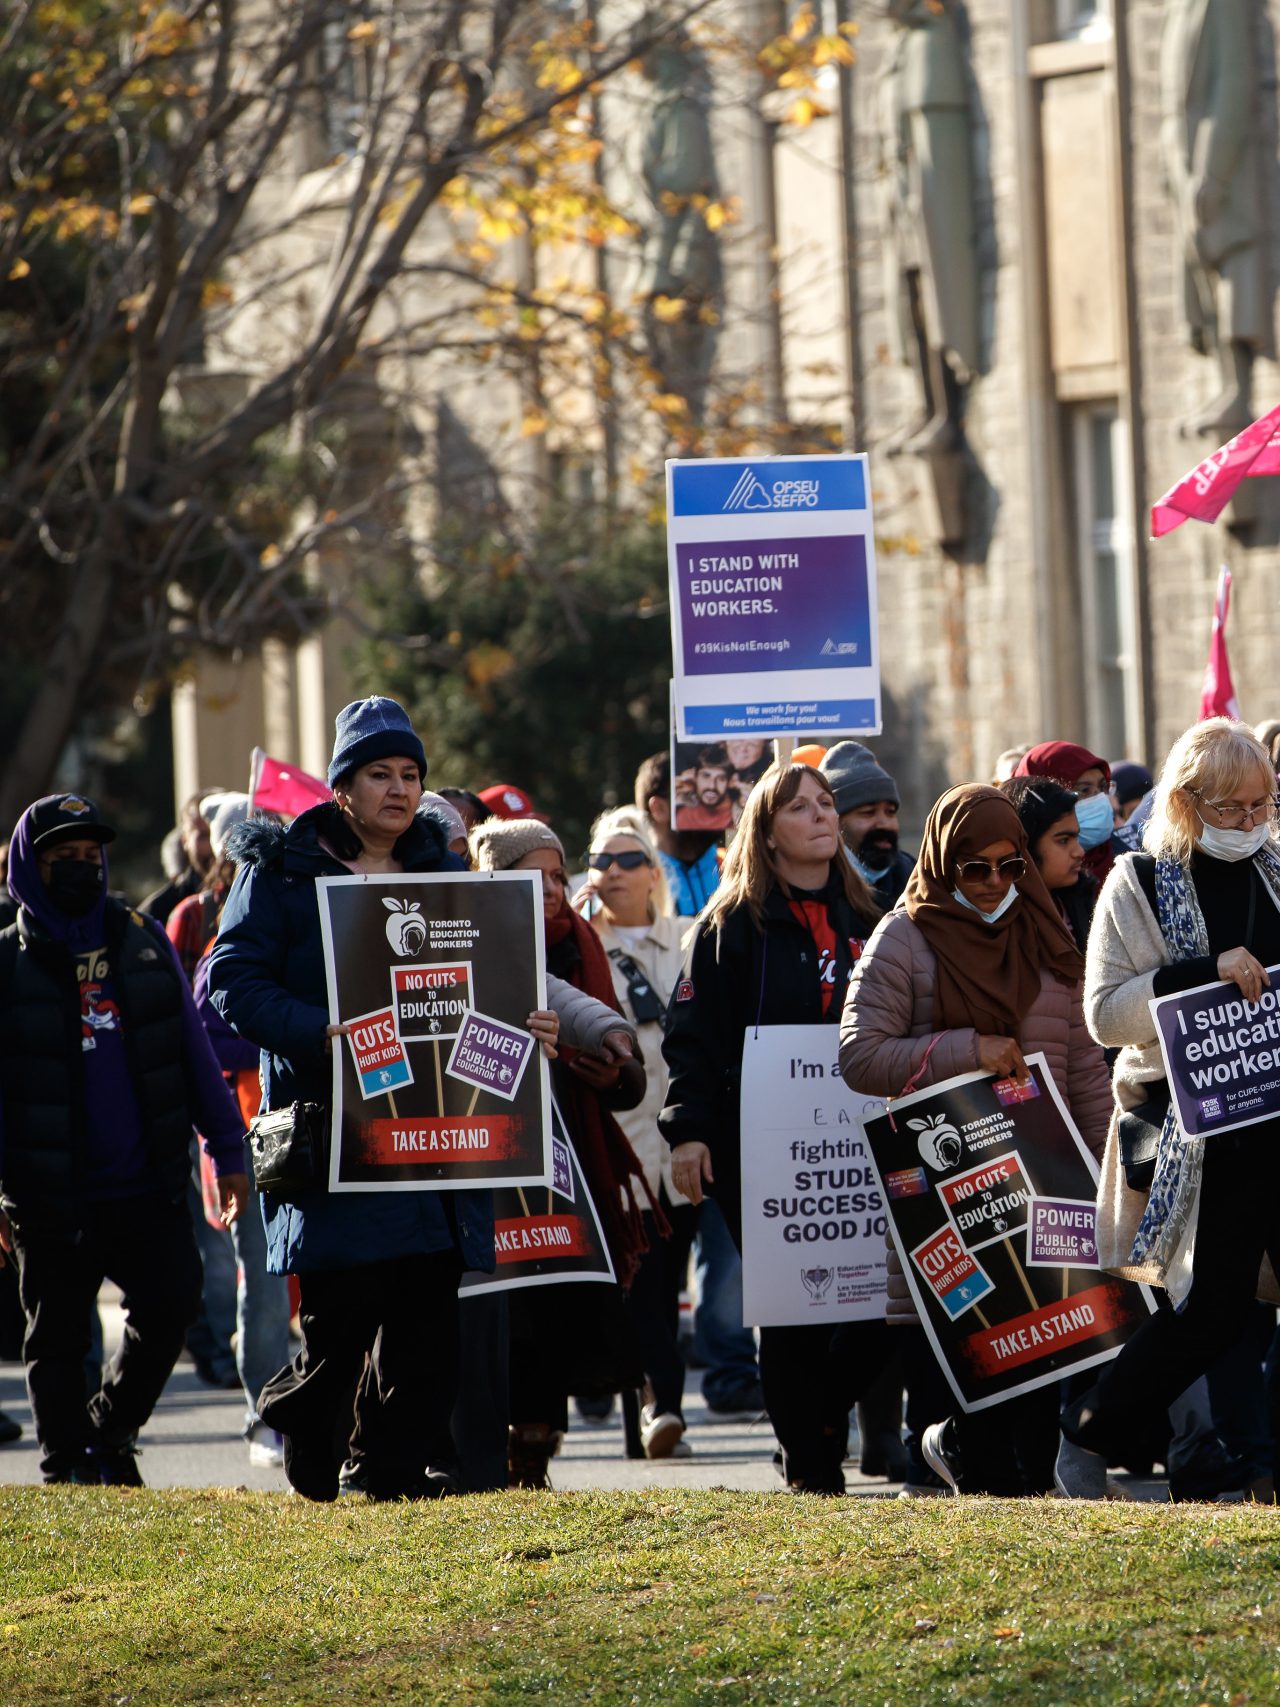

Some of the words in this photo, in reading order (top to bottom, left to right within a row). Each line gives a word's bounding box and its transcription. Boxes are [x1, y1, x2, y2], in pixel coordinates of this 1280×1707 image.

[772, 480, 820, 495] OPSEU
[772, 493, 818, 508] SEFPO
[688, 558, 694, 573] I
[698, 555, 754, 572] STAND
[758, 553, 799, 569] WITH
[690, 576, 782, 595] EDUCATION
[692, 598, 779, 617] WORKERS.
[694, 640, 790, 654] #39KisNotEnough
[429, 920, 471, 928] TORONTO
[430, 929, 480, 939] EDUCATION
[430, 940, 473, 949] WORKERS
[405, 974, 424, 991] NO
[425, 972, 457, 990] CUTS
[427, 990, 437, 1000] TO
[400, 999, 468, 1019] EDUCATION
[1176, 1010, 1188, 1036] I
[352, 1019, 395, 1051] CUTS
[462, 1038, 472, 1048] OF
[465, 1023, 523, 1060] POWER
[358, 1051, 382, 1069] HURT
[381, 1044, 401, 1062] KIDS
[458, 1047, 499, 1072] PUBLIC
[455, 1058, 496, 1082] EDUCATION
[790, 1058, 824, 1080] I'm
[1226, 1093, 1237, 1102] for
[1228, 1104, 1236, 1112] or
[960, 1112, 1004, 1134] TORONTO
[964, 1119, 1016, 1143] EDUCATION
[391, 1130, 428, 1152] TAKE
[429, 1131, 438, 1151] A
[440, 1128, 490, 1150] STAND
[967, 1131, 1014, 1153] WORKERS
[789, 1139, 868, 1165] fightin
[794, 1167, 876, 1192] STUDE
[953, 1178, 975, 1202] NO
[974, 1165, 1011, 1193] CUTS
[762, 1191, 884, 1219] SUCCESS
[982, 1190, 993, 1202] TO
[957, 1187, 1030, 1232] EDUCATION
[1036, 1208, 1095, 1230] POWER
[521, 1230, 532, 1247] A
[533, 1226, 572, 1247] STAND
[782, 1220, 858, 1244] GOOD
[862, 1215, 888, 1238] JO
[1036, 1225, 1045, 1233] OF
[1034, 1246, 1079, 1257] EDUCATION
[1035, 1233, 1078, 1249] PUBLIC
[922, 1235, 962, 1277] CUTS
[933, 1271, 953, 1292] HURT
[952, 1257, 974, 1281] KIDS
[989, 1328, 1032, 1361] TAKE
[1030, 1326, 1042, 1347] A
[1041, 1304, 1096, 1342] STAND
